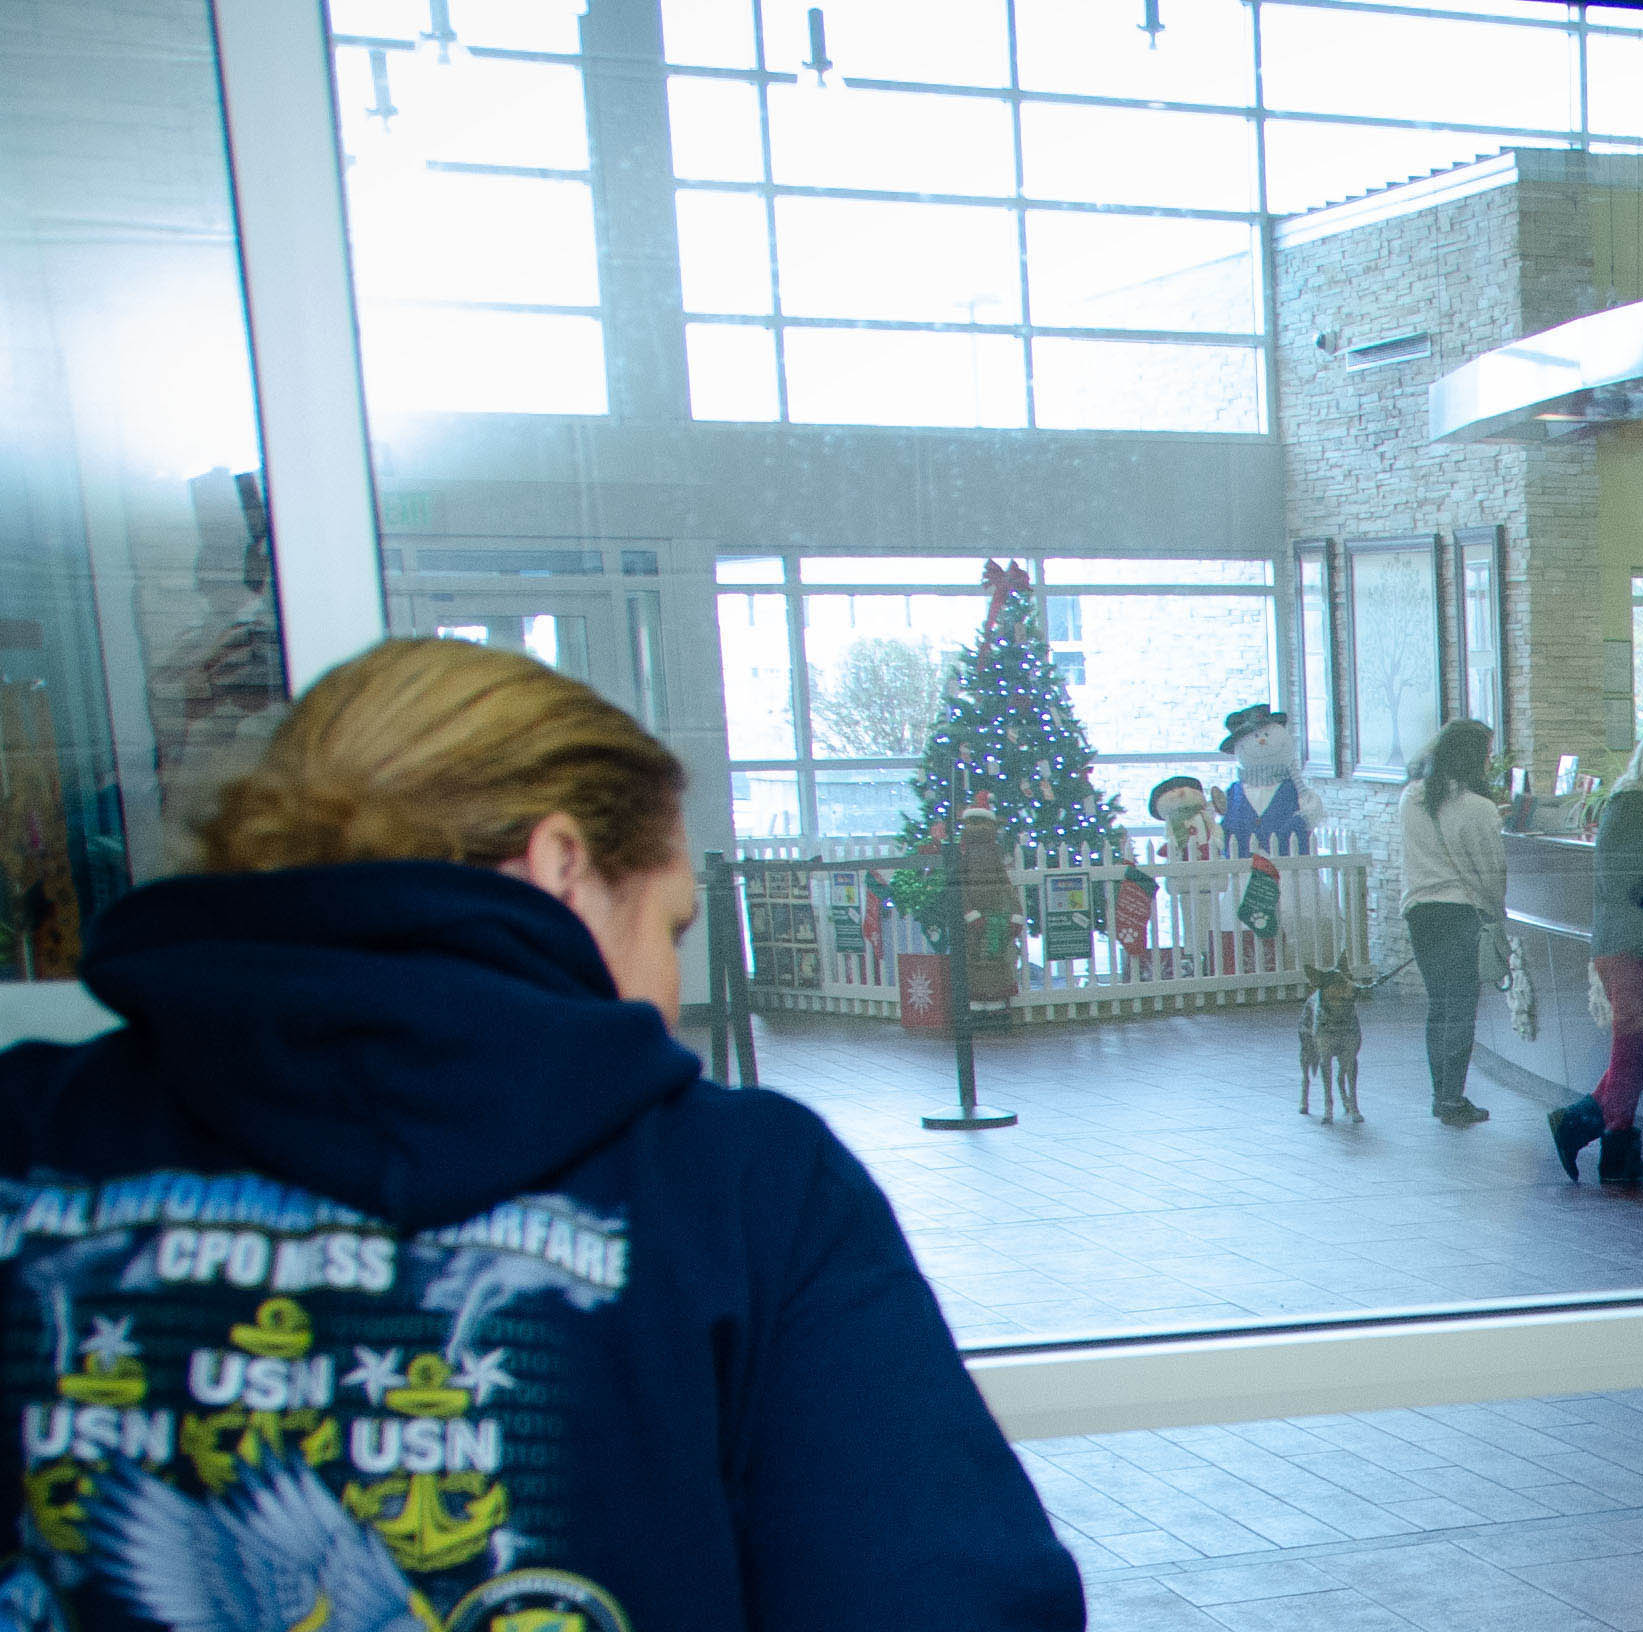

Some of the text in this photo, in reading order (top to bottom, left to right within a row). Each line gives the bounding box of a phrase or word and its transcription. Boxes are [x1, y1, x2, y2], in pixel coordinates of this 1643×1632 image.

[157, 1230, 270, 1289] CPO
[187, 1348, 336, 1411] USN
[22, 1405, 175, 1465] USN
[348, 1416, 500, 1476] USN
